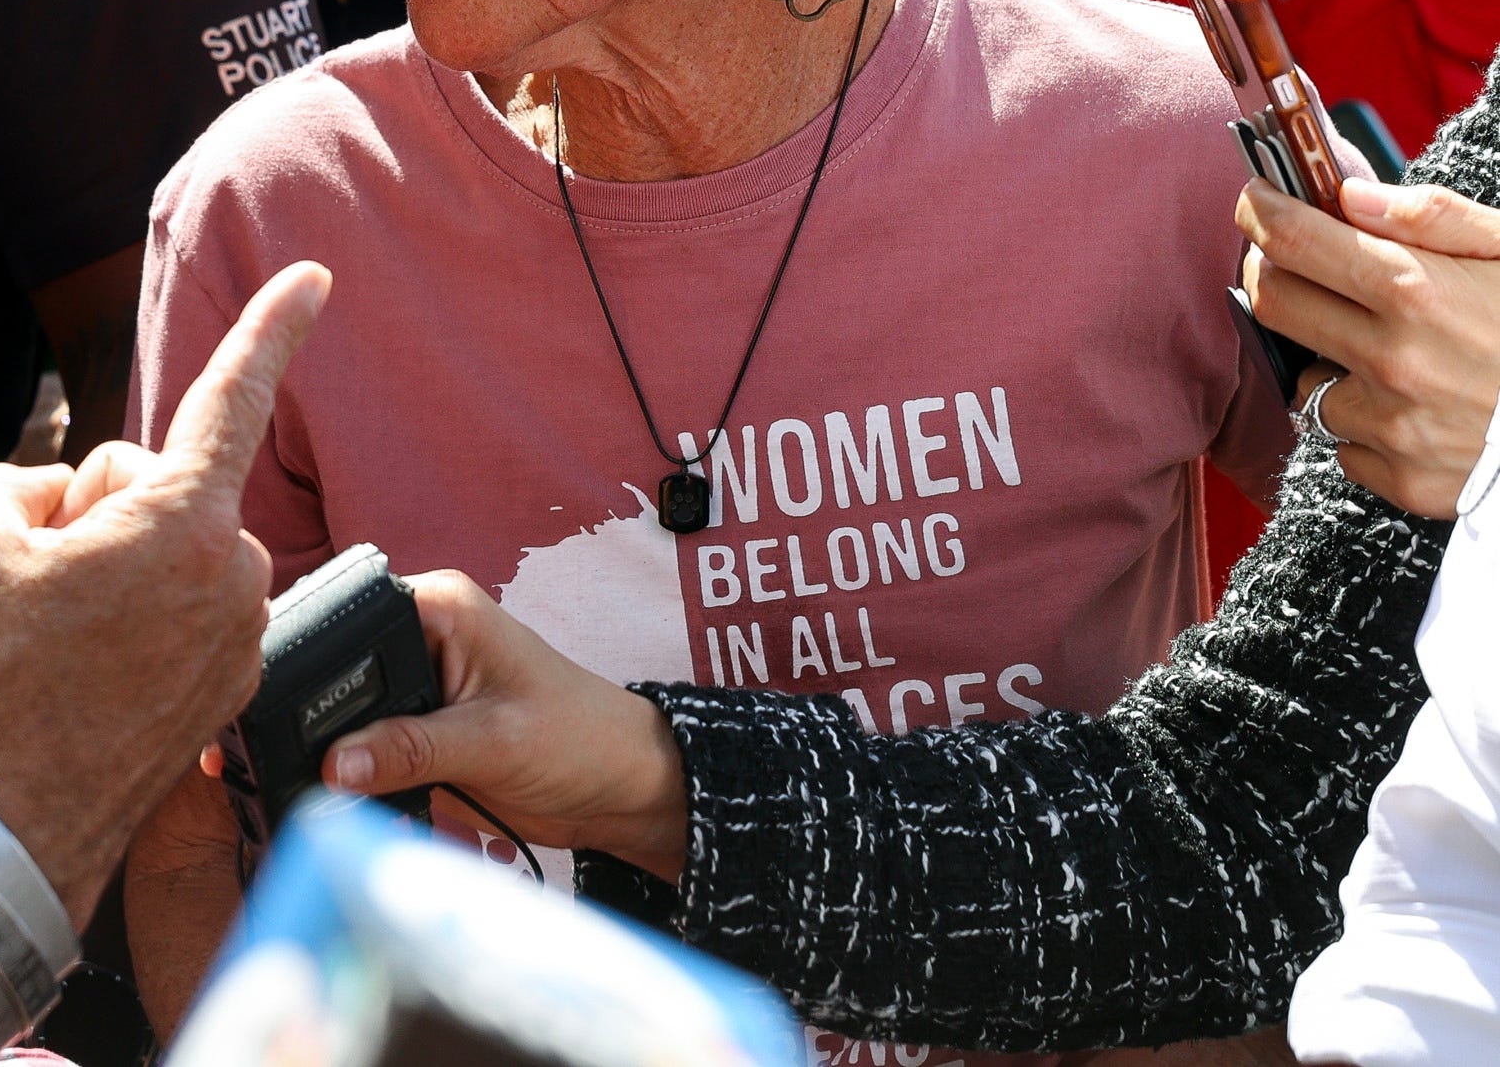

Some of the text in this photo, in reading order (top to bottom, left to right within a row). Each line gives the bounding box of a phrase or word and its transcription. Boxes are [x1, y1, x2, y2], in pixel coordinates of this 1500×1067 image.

[677, 386, 1023, 529] WOMEN
[697, 511, 967, 608] BELONG
[706, 606, 897, 686] IN ALL
[304, 667, 367, 726] SONY
[840, 662, 1048, 734] ACES
